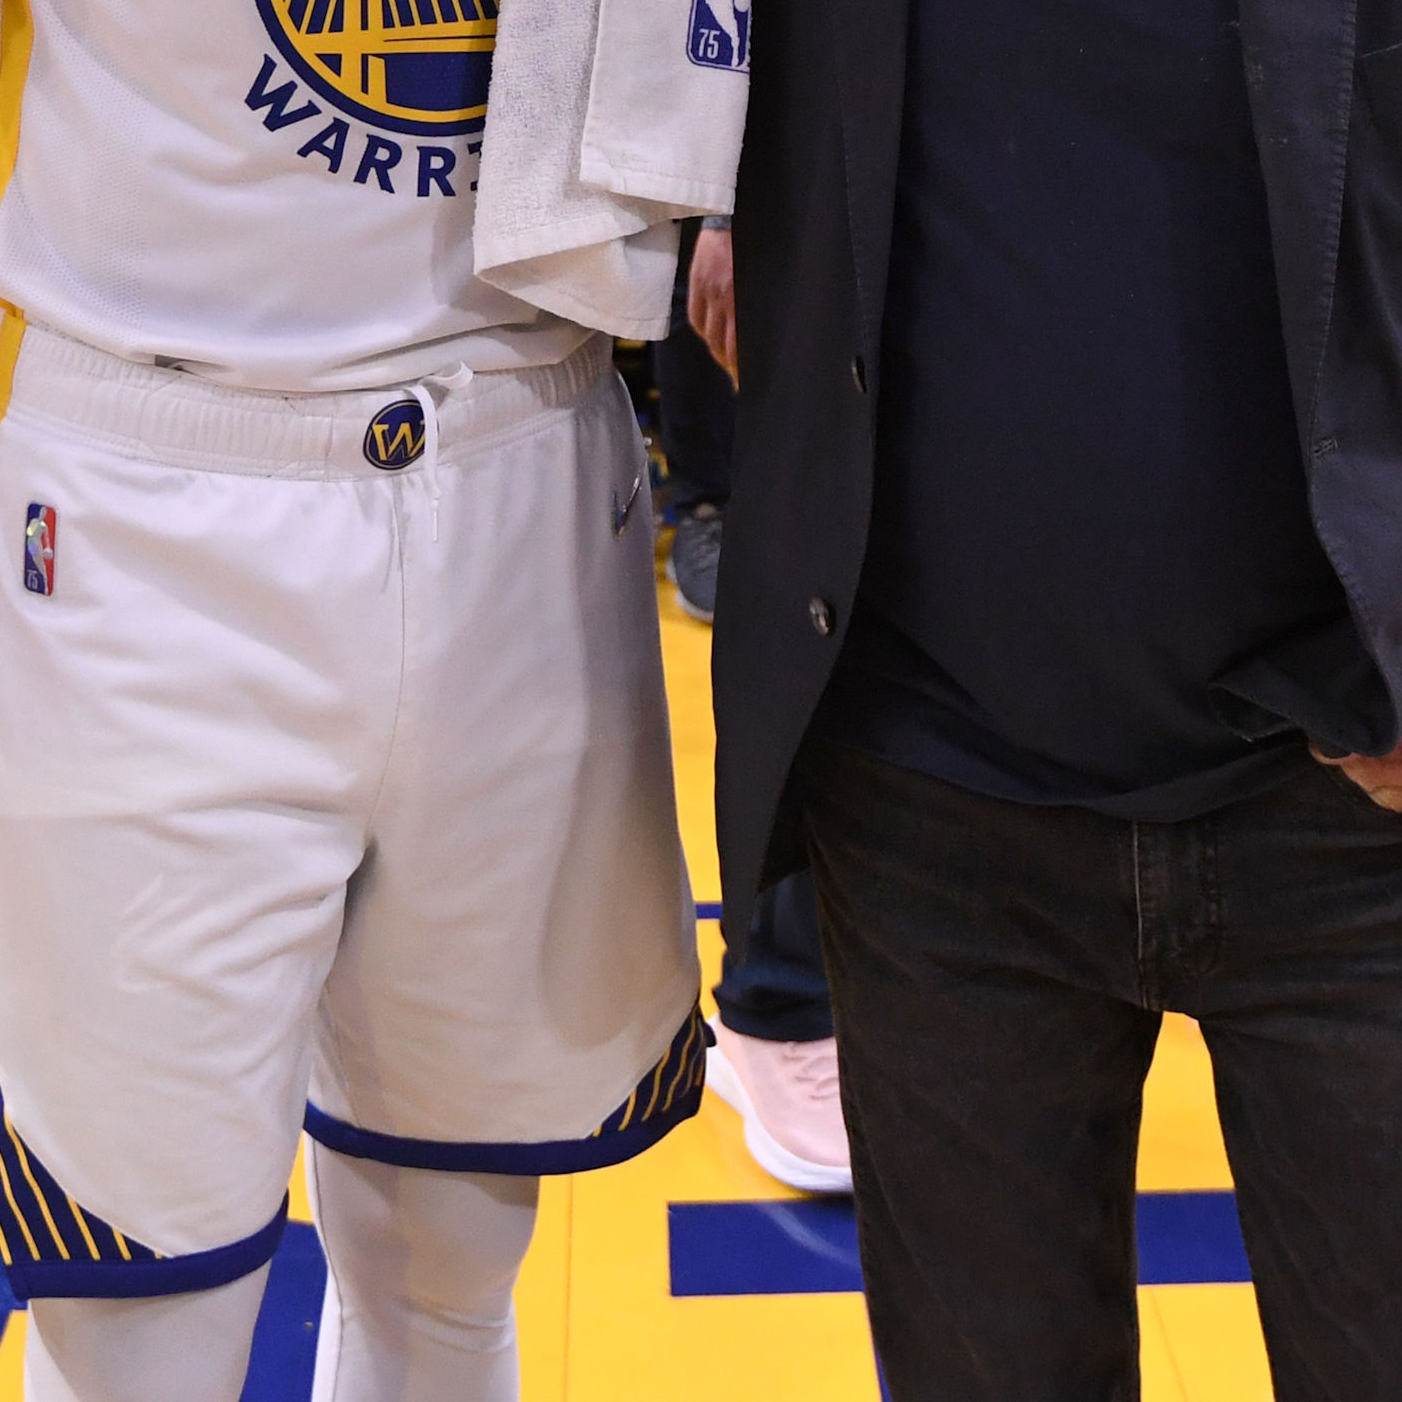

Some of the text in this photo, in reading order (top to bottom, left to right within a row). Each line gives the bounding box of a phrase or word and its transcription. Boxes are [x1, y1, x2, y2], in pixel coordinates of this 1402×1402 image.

[699, 29, 721, 59] 75
[372, 420, 426, 461] W
[27, 570, 39, 590] 75
